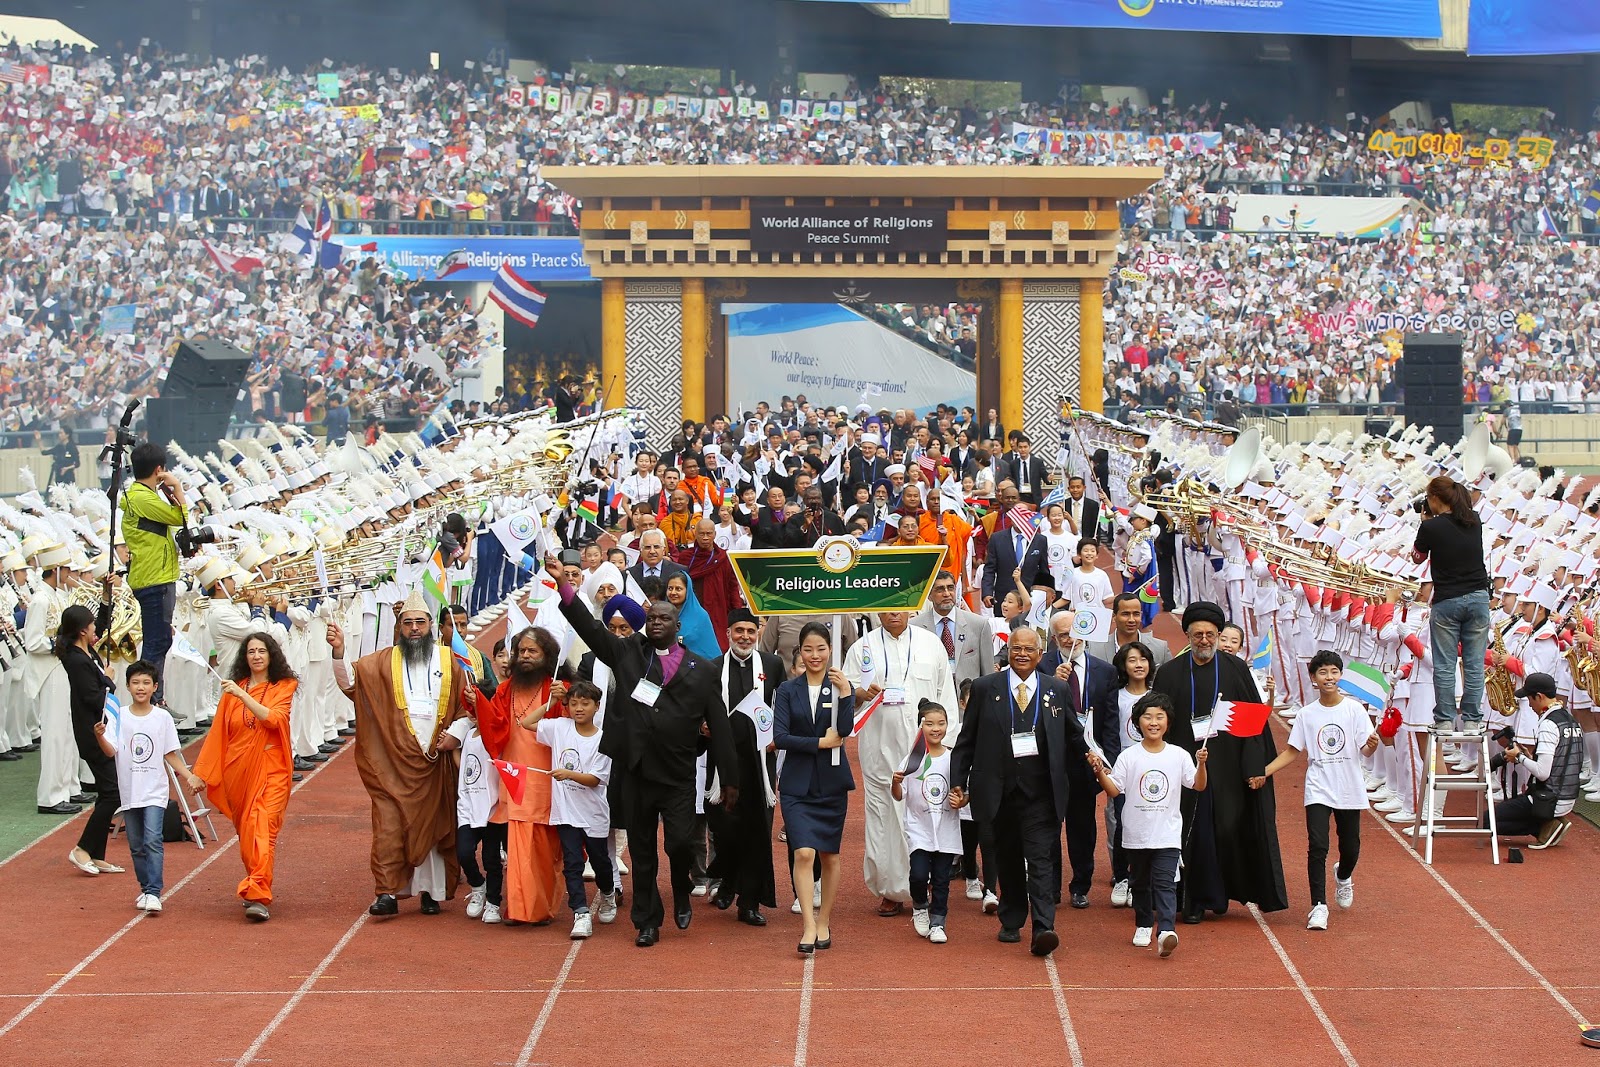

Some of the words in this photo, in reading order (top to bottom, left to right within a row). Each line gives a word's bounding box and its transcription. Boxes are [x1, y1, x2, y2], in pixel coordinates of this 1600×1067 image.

[1235, 0, 1258, 8] PEACE
[1259, 0, 1283, 8] GROUP
[762, 217, 799, 228] World
[801, 217, 851, 228] Alliance
[853, 217, 869, 228] of
[873, 217, 933, 231] Religions
[807, 233, 840, 244] Peace
[843, 233, 890, 244] Summit
[391, 250, 443, 267] Alliance
[466, 251, 527, 271] Religions
[531, 252, 568, 267] Peace
[1365, 313, 1425, 333] want
[771, 350, 793, 364] World
[786, 372, 800, 383] our
[801, 371, 823, 388] legacy
[824, 375, 832, 386] to
[831, 374, 856, 389] future
[855, 379, 908, 393] geations!
[775, 577, 842, 593] Religious
[845, 574, 901, 589] Leaders
